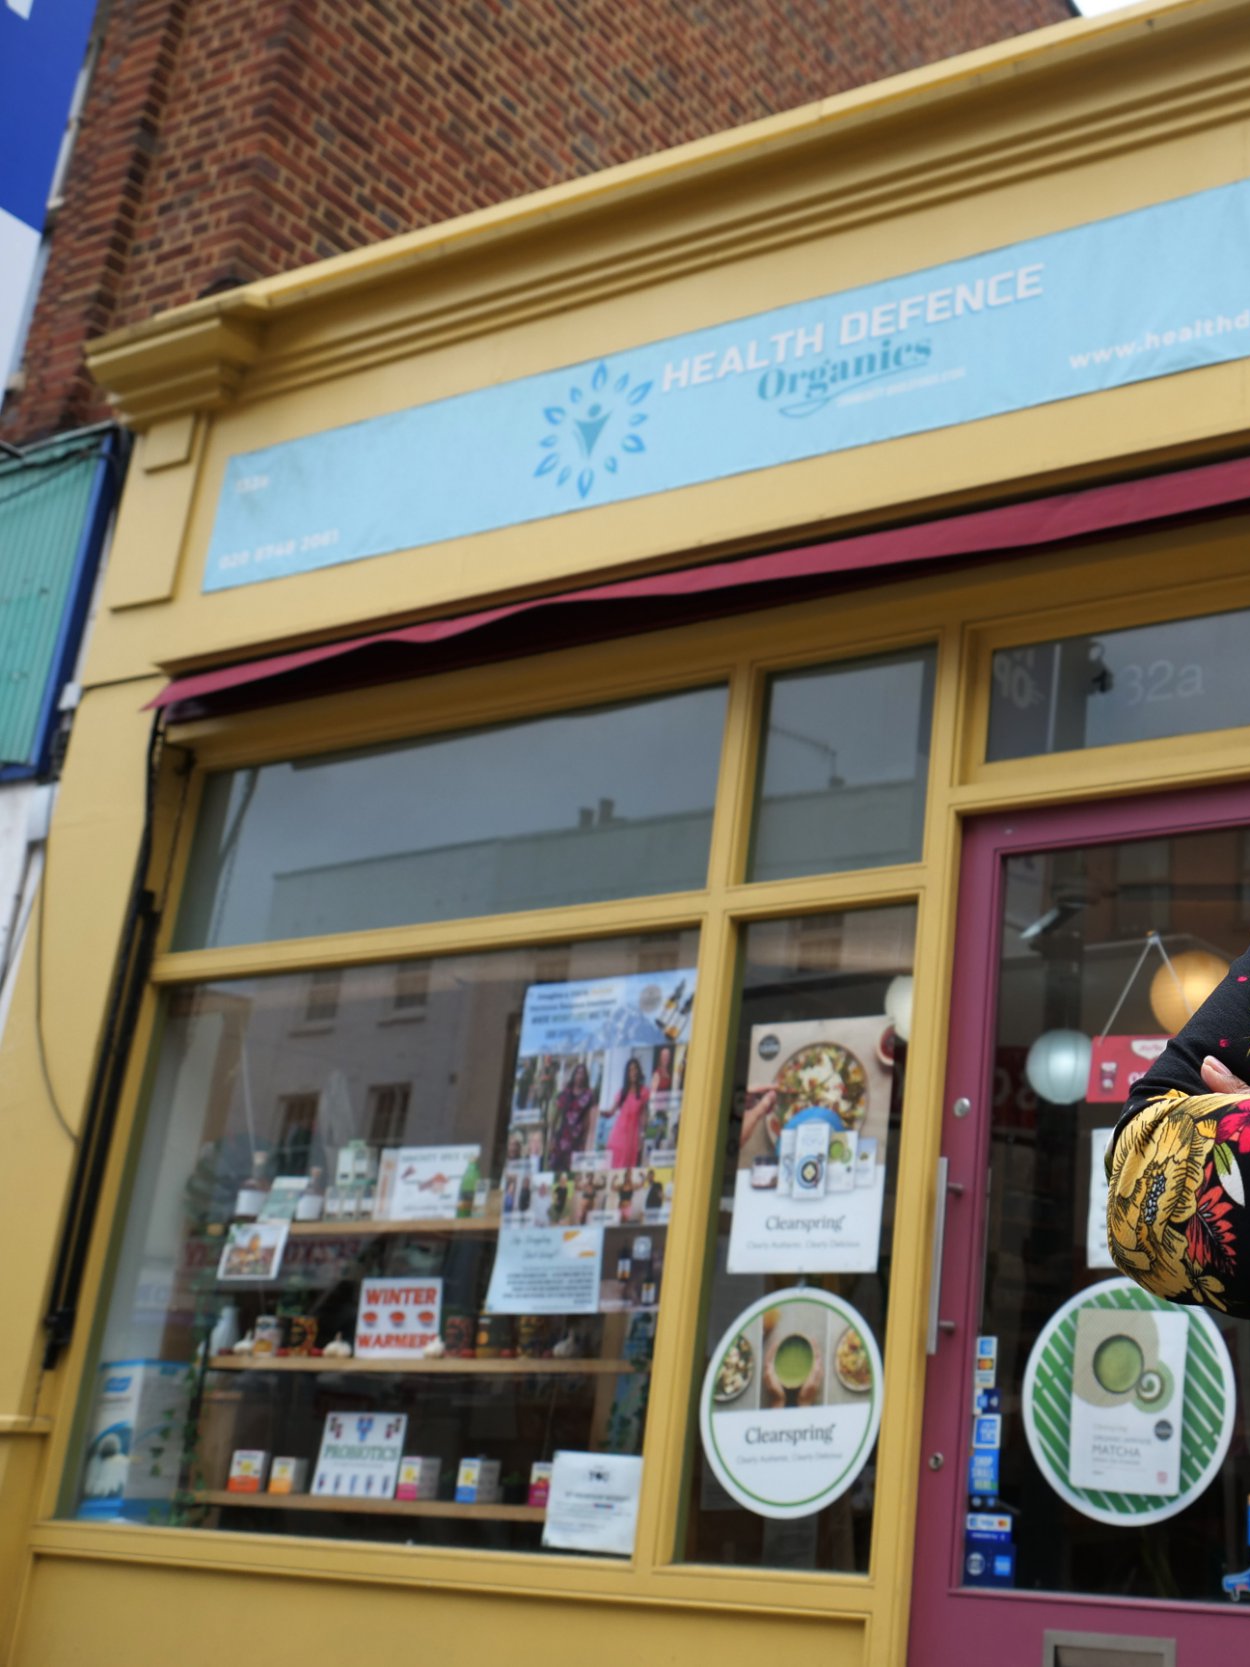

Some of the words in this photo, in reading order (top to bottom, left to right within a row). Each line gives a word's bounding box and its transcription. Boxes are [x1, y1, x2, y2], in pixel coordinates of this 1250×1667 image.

[662, 322, 824, 393] HEALTH
[839, 262, 1044, 346] DEFENCE
[757, 337, 932, 400] Organics
[765, 1214, 846, 1233] Clearspring
[366, 1286, 438, 1305] WINTER
[745, 1423, 836, 1446] Clearspring
[1092, 1443, 1142, 1459] MATCHA
